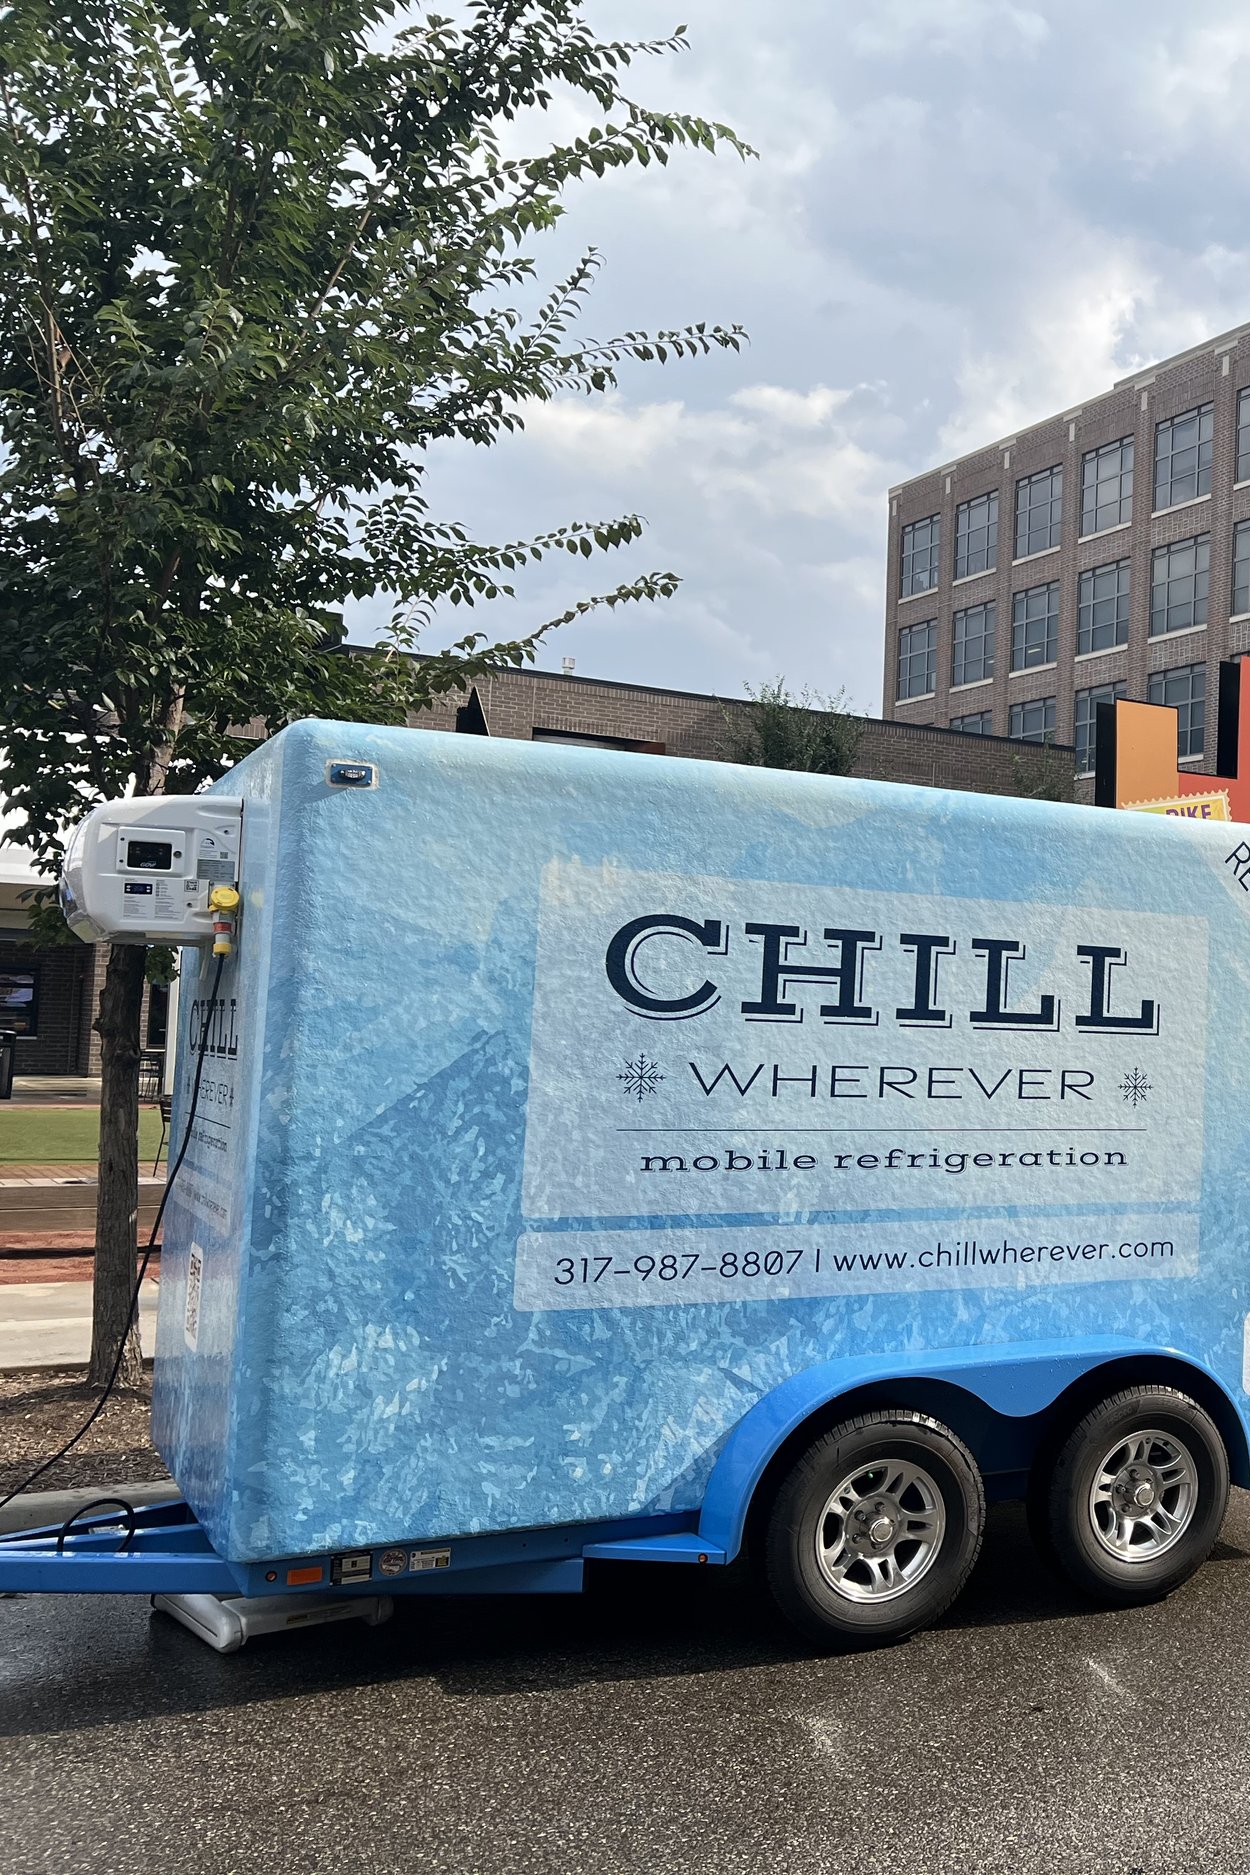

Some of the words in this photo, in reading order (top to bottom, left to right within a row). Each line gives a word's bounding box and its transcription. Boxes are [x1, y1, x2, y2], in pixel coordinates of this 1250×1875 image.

[604, 912, 1161, 1038] CHILL
[687, 1061, 1096, 1102] WHEREVER
[639, 1147, 819, 1174] mobile
[832, 1144, 1129, 1176] refrigeration
[553, 1248, 805, 1286] 317-987-8807
[832, 1236, 1176, 1273] www.chillwherever.com
